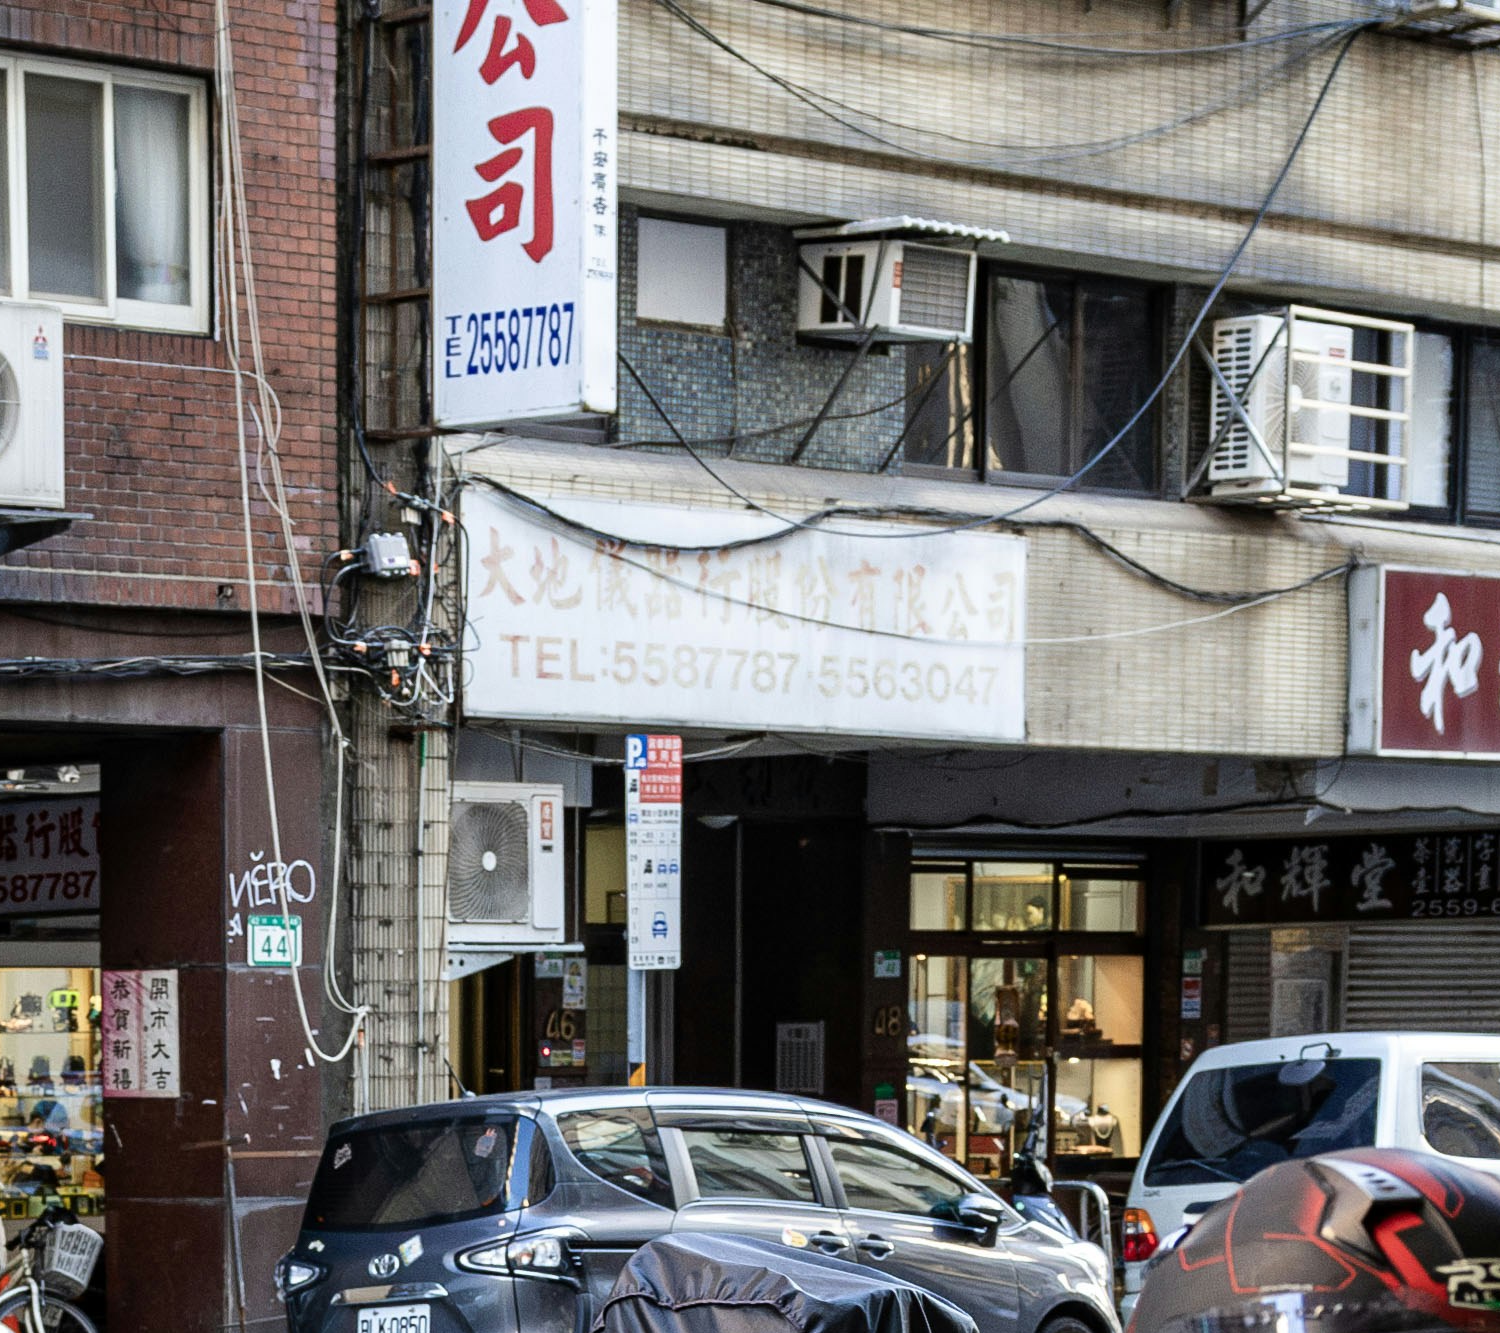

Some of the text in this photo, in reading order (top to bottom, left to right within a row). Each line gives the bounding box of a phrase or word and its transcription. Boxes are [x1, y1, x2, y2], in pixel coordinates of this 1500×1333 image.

[453, 0, 569, 263] 公司
[445, 302, 574, 378] TEL 25587787
[628, 737, 643, 768] P
[1216, 842, 1396, 915] 和輝堂
[261, 935, 288, 957] 44
[149, 977, 171, 1090] 開市大吉
